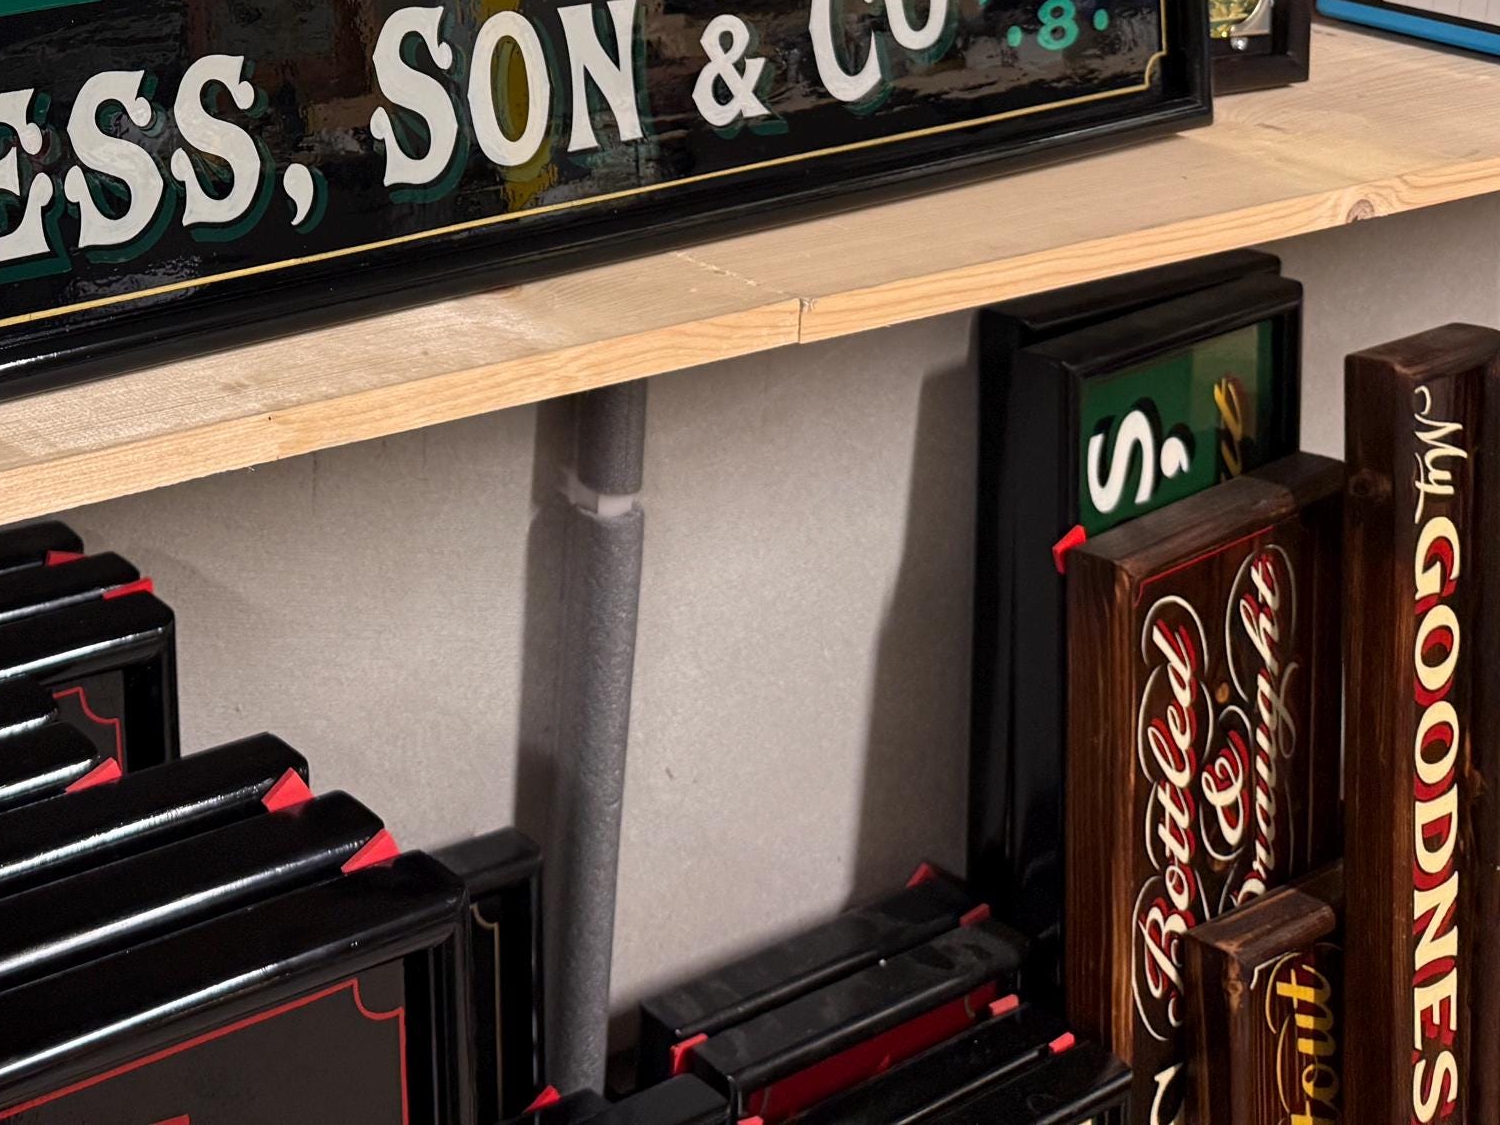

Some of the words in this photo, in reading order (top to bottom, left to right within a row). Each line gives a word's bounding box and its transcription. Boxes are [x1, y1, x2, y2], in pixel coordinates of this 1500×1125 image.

[691, 13, 771, 129] &
[1414, 385, 1469, 524] My
[1136, 618, 1198, 1028] Bottled
